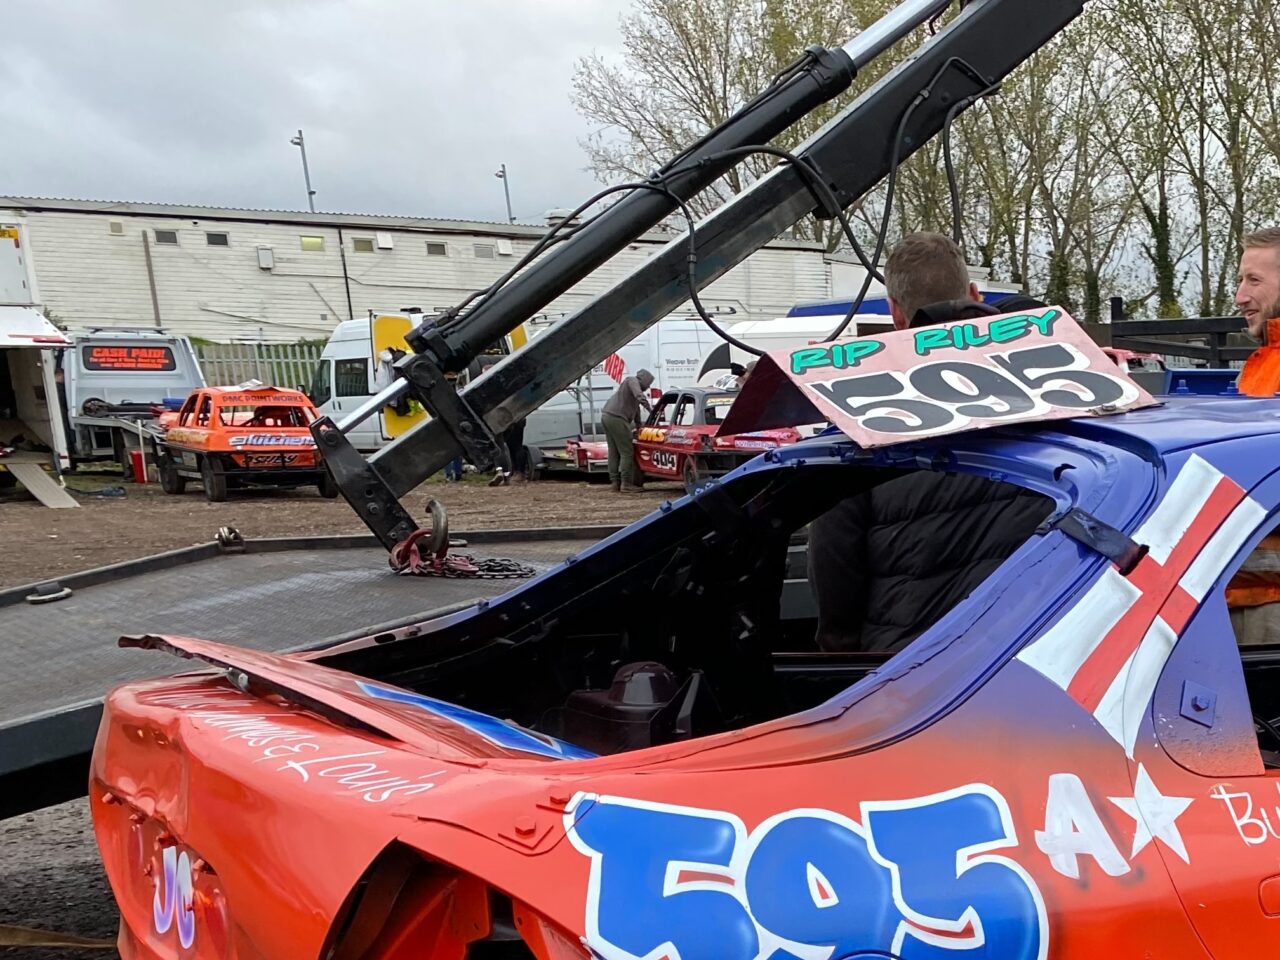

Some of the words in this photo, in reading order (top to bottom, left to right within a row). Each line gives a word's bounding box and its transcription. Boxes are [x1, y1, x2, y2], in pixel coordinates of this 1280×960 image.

[92, 348, 128, 358] CASH
[789, 340, 887, 376] RIP
[914, 309, 1063, 358] RILEY
[806, 342, 1140, 436] 595
[652, 450, 677, 471] 404
[277, 750, 447, 802] Louis
